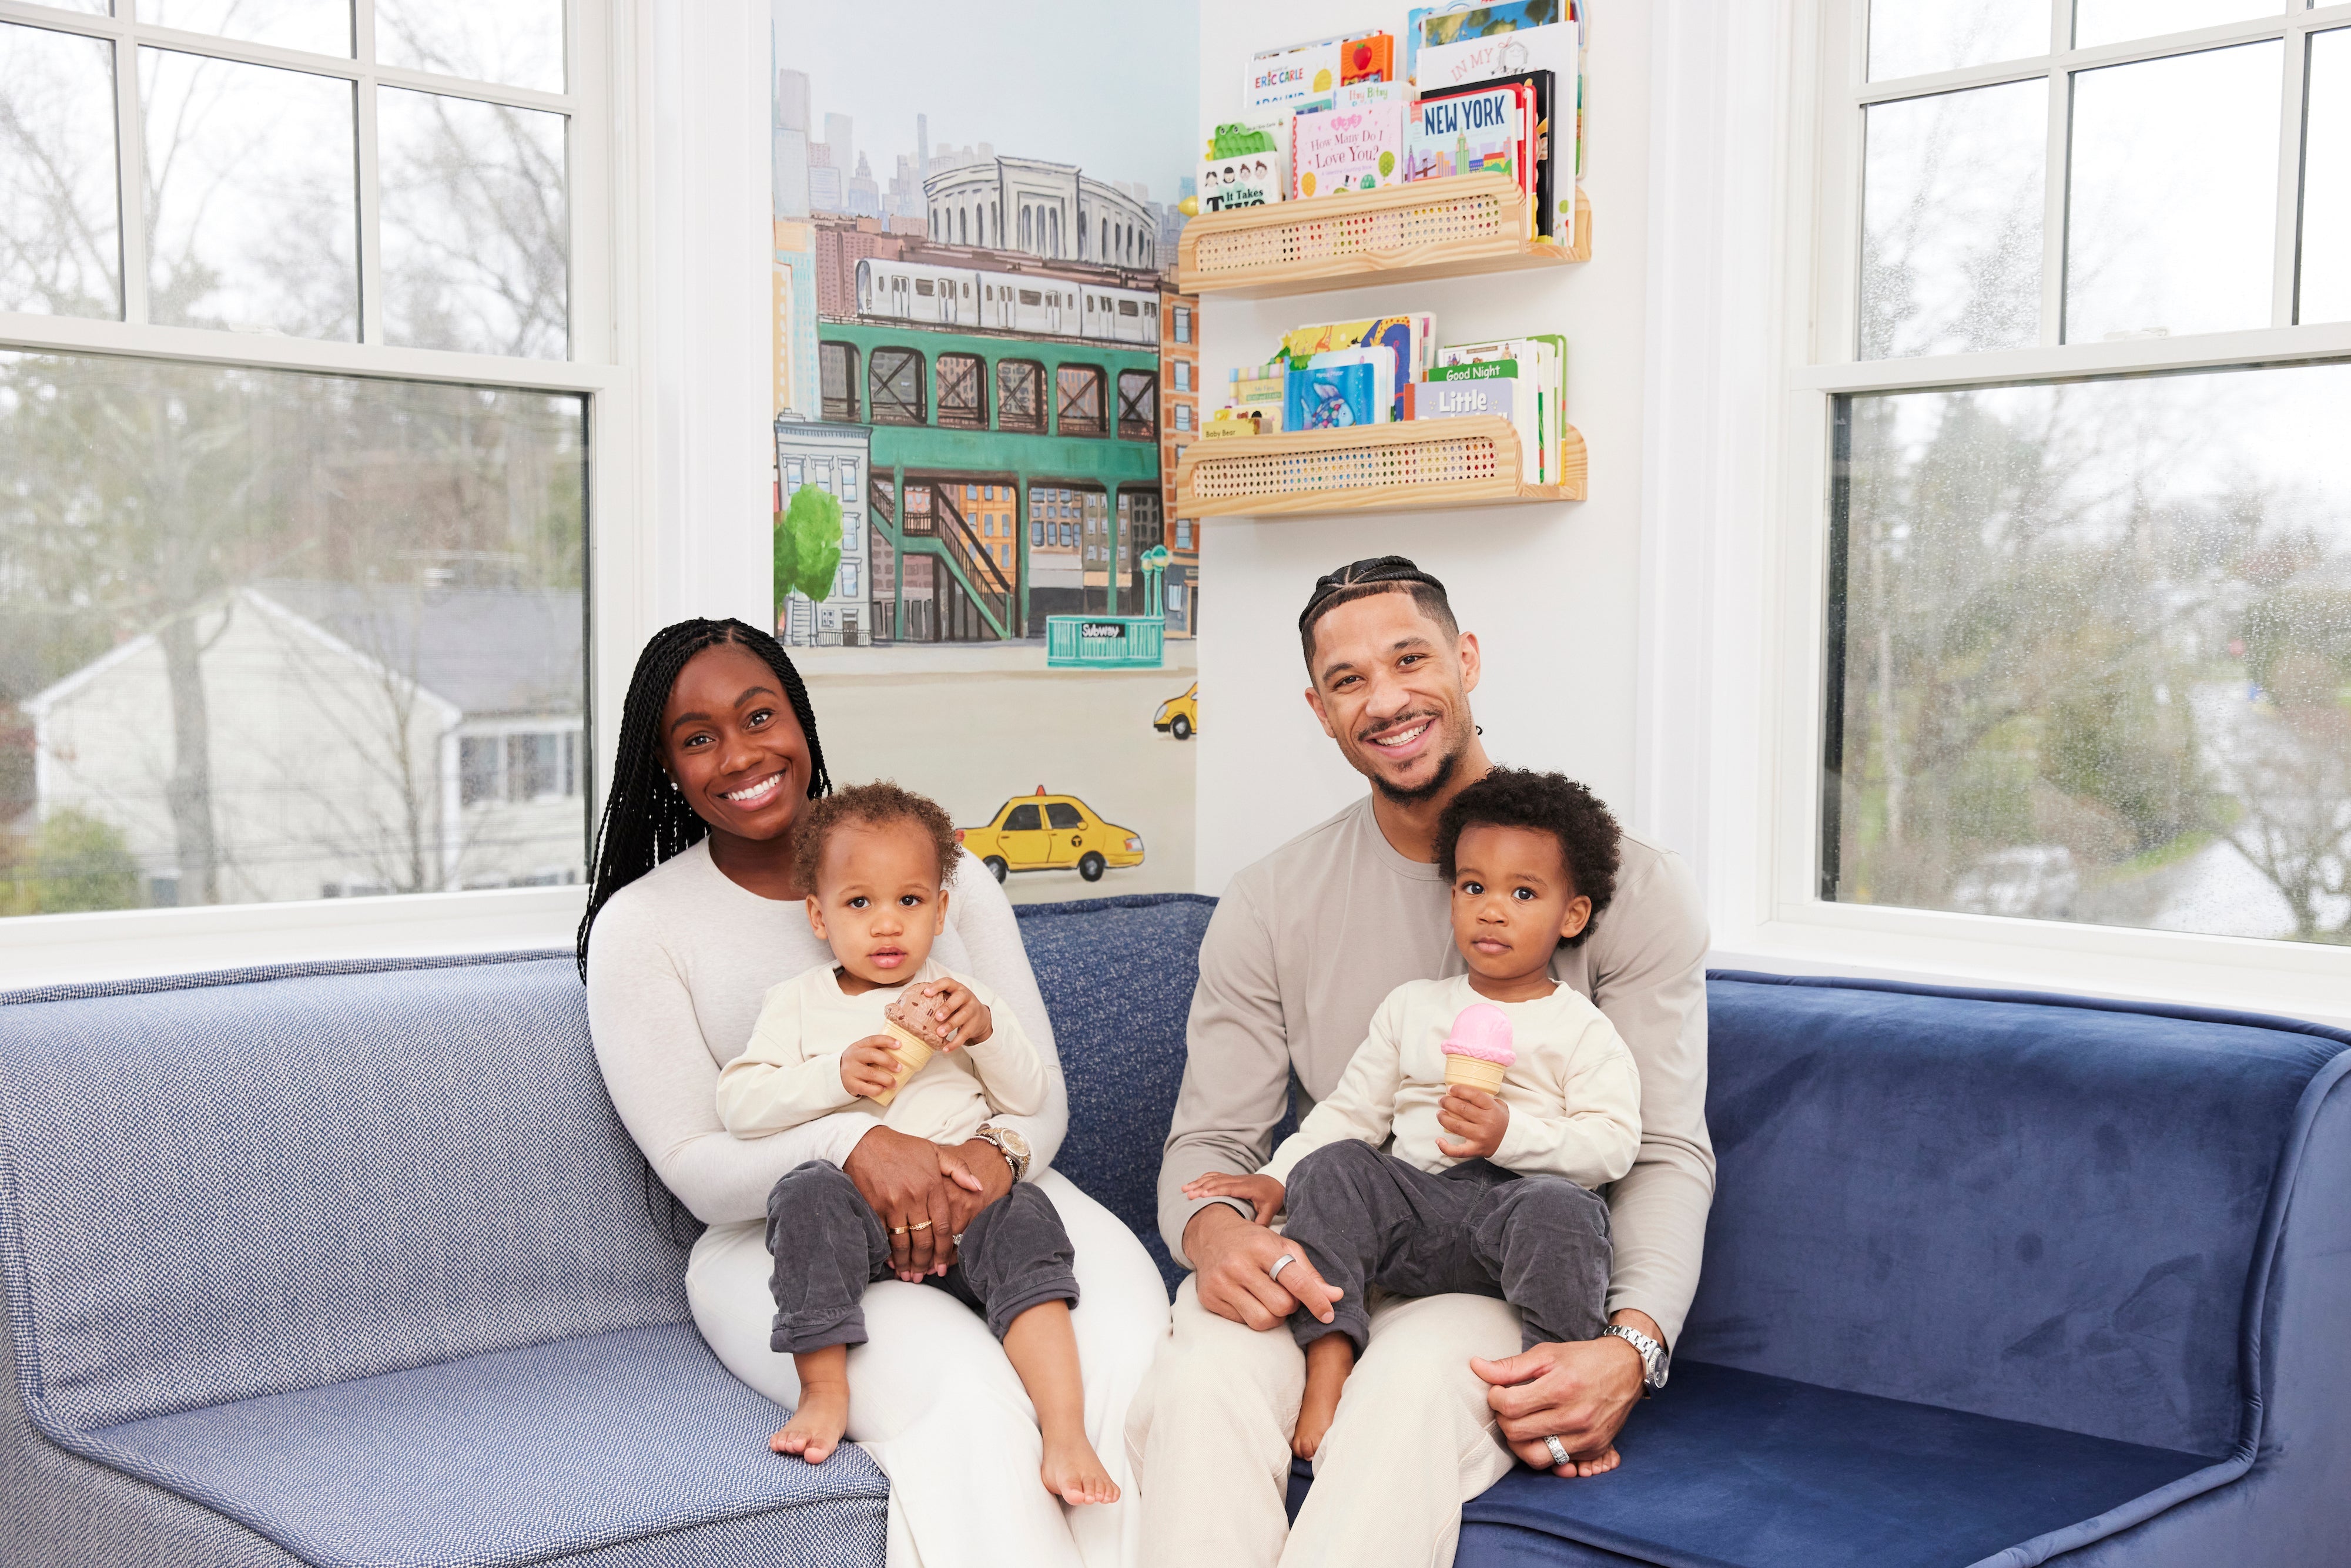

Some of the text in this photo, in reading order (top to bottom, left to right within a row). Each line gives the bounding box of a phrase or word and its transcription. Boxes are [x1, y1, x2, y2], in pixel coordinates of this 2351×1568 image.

[1451, 48, 1493, 82] IN MY
[1279, 68, 1304, 83] CARLE
[1425, 95, 1505, 136] NEW YORK
[1311, 130, 1383, 151] How Many Do I
[1316, 145, 1379, 169] Love You?
[1226, 189, 1264, 202] It Takes
[1446, 364, 1501, 381] Good Night
[1439, 388, 1488, 412] Little
[1205, 430, 1221, 440] Baby
[1082, 624, 1120, 638] Subway
